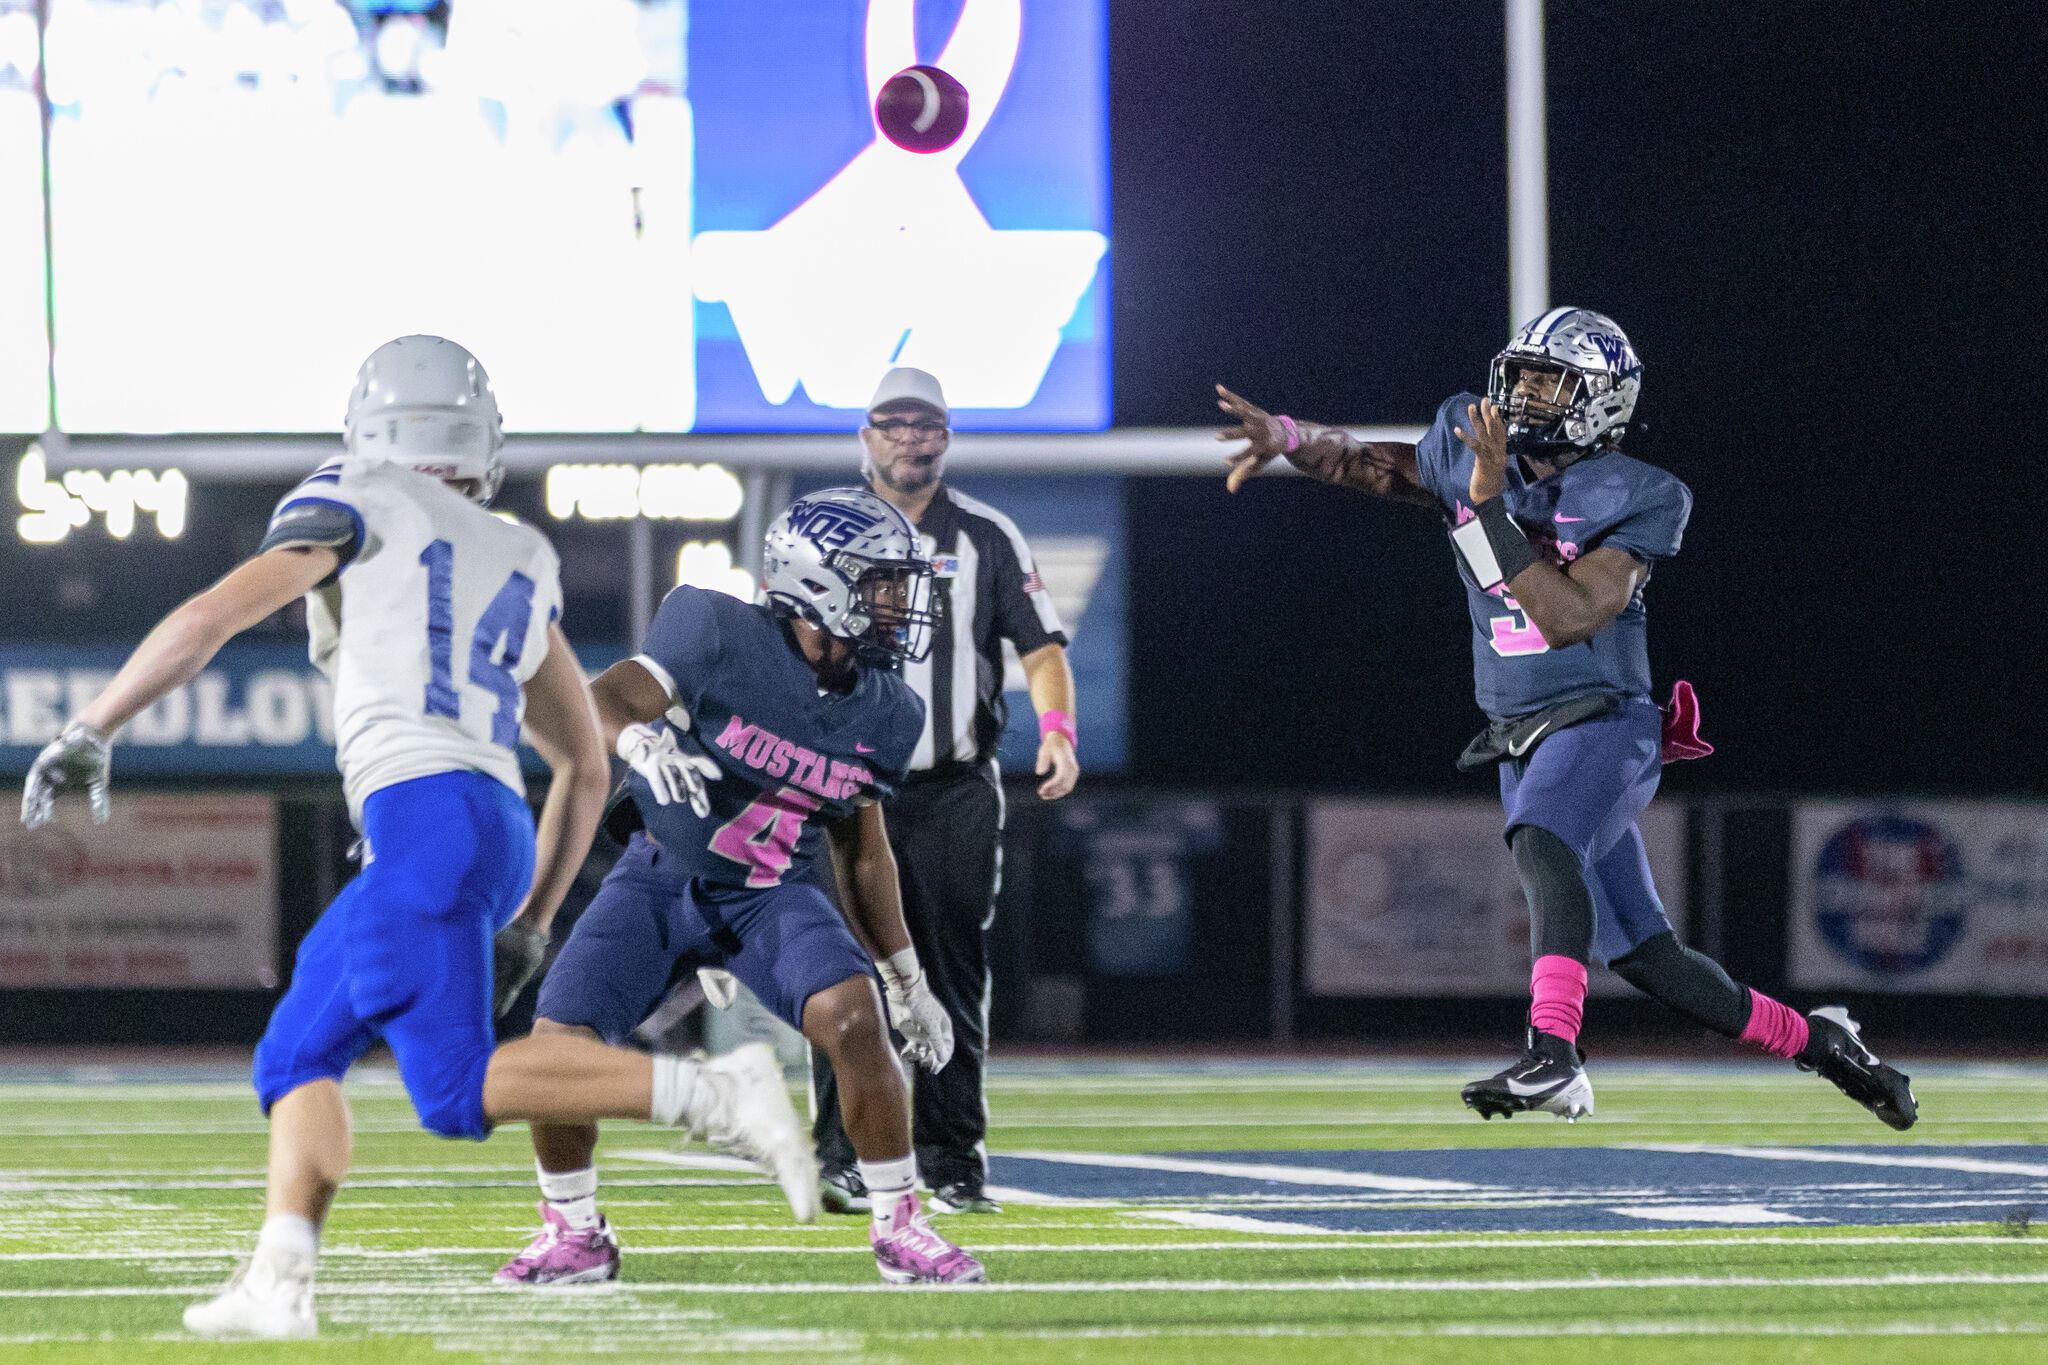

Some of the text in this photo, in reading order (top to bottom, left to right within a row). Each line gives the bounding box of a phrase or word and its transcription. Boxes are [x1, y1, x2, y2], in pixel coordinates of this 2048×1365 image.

[786, 500, 880, 550] WOS
[419, 538, 537, 750] 14
[707, 786, 824, 889] 4
